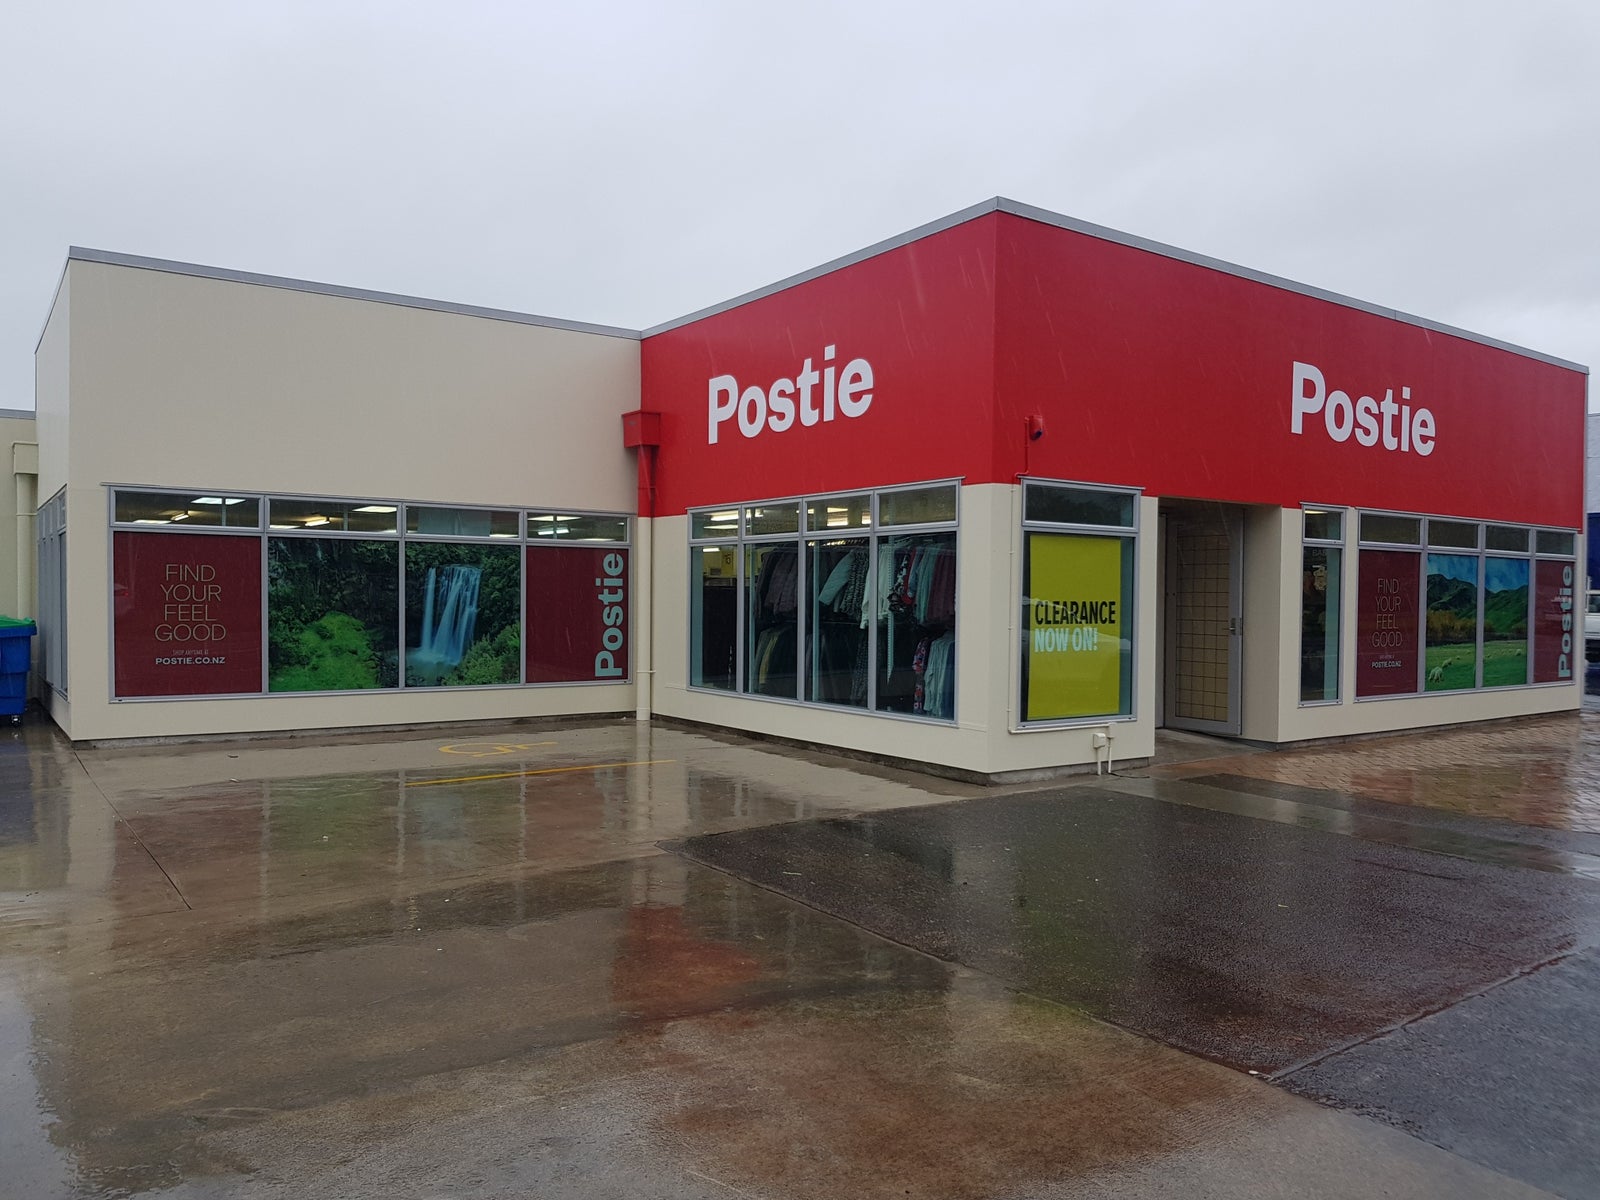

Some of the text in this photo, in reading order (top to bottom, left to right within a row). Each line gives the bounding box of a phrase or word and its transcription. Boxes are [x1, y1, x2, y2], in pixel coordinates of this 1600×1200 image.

[708, 344, 874, 445] Postie
[1290, 360, 1436, 457] Postie
[165, 564, 216, 582] FIND
[160, 584, 222, 602] YOUR
[1377, 578, 1399, 594] FIND
[164, 604, 217, 622] FEEL
[1034, 601, 1117, 625] CLEARANCE
[1375, 596, 1402, 612] YOUR
[594, 552, 624, 677] Postie
[1376, 613, 1399, 630] FEEL
[1558, 565, 1573, 678] Postie
[154, 623, 226, 642] GOOD
[1034, 627, 1098, 652] NOW ON!
[1371, 631, 1403, 648] GOOD
[155, 656, 226, 665] POSTIE.CO.NZ
